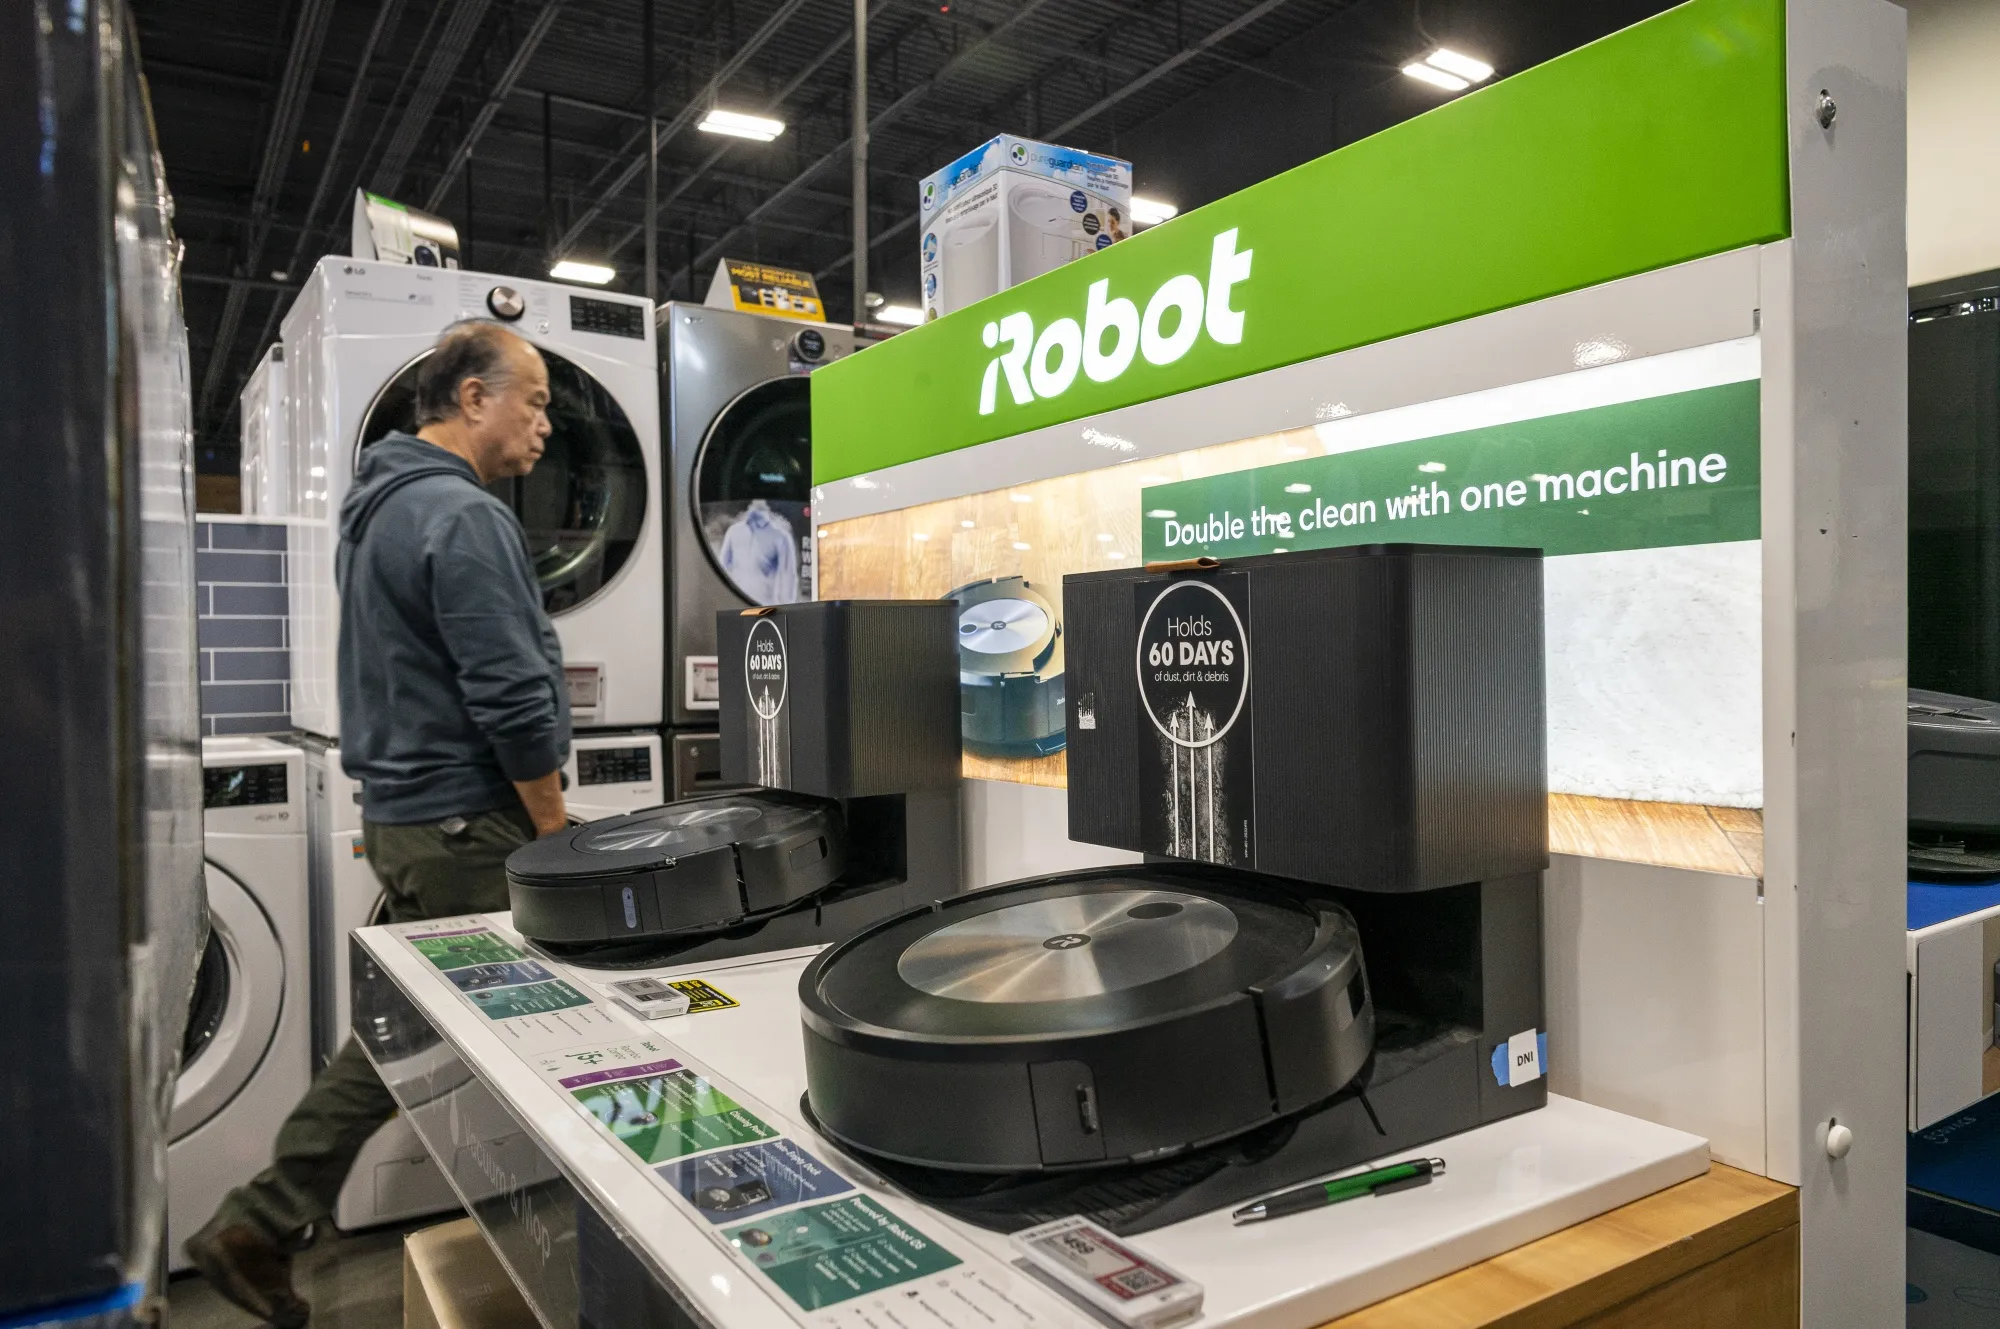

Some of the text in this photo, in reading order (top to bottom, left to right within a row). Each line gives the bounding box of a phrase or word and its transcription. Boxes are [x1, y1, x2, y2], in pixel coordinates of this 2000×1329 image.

[1164, 449, 1728, 548] Double the clean with one machine
[1167, 614, 1212, 637] Holds
[756, 639, 775, 653] Holds
[1148, 639, 1234, 667] 60 DAYS
[750, 653, 782, 671] 60 DAYS
[1154, 670, 1229, 683] of dust, dirt & debris
[564, 1050, 604, 1065] j5+
[1517, 1051, 1534, 1067] DNI
[803, 1163, 822, 1176] Dock
[463, 1112, 508, 1202] Vacuum
[521, 1185, 552, 1268] Mop
[850, 1197, 884, 1220] Powered
